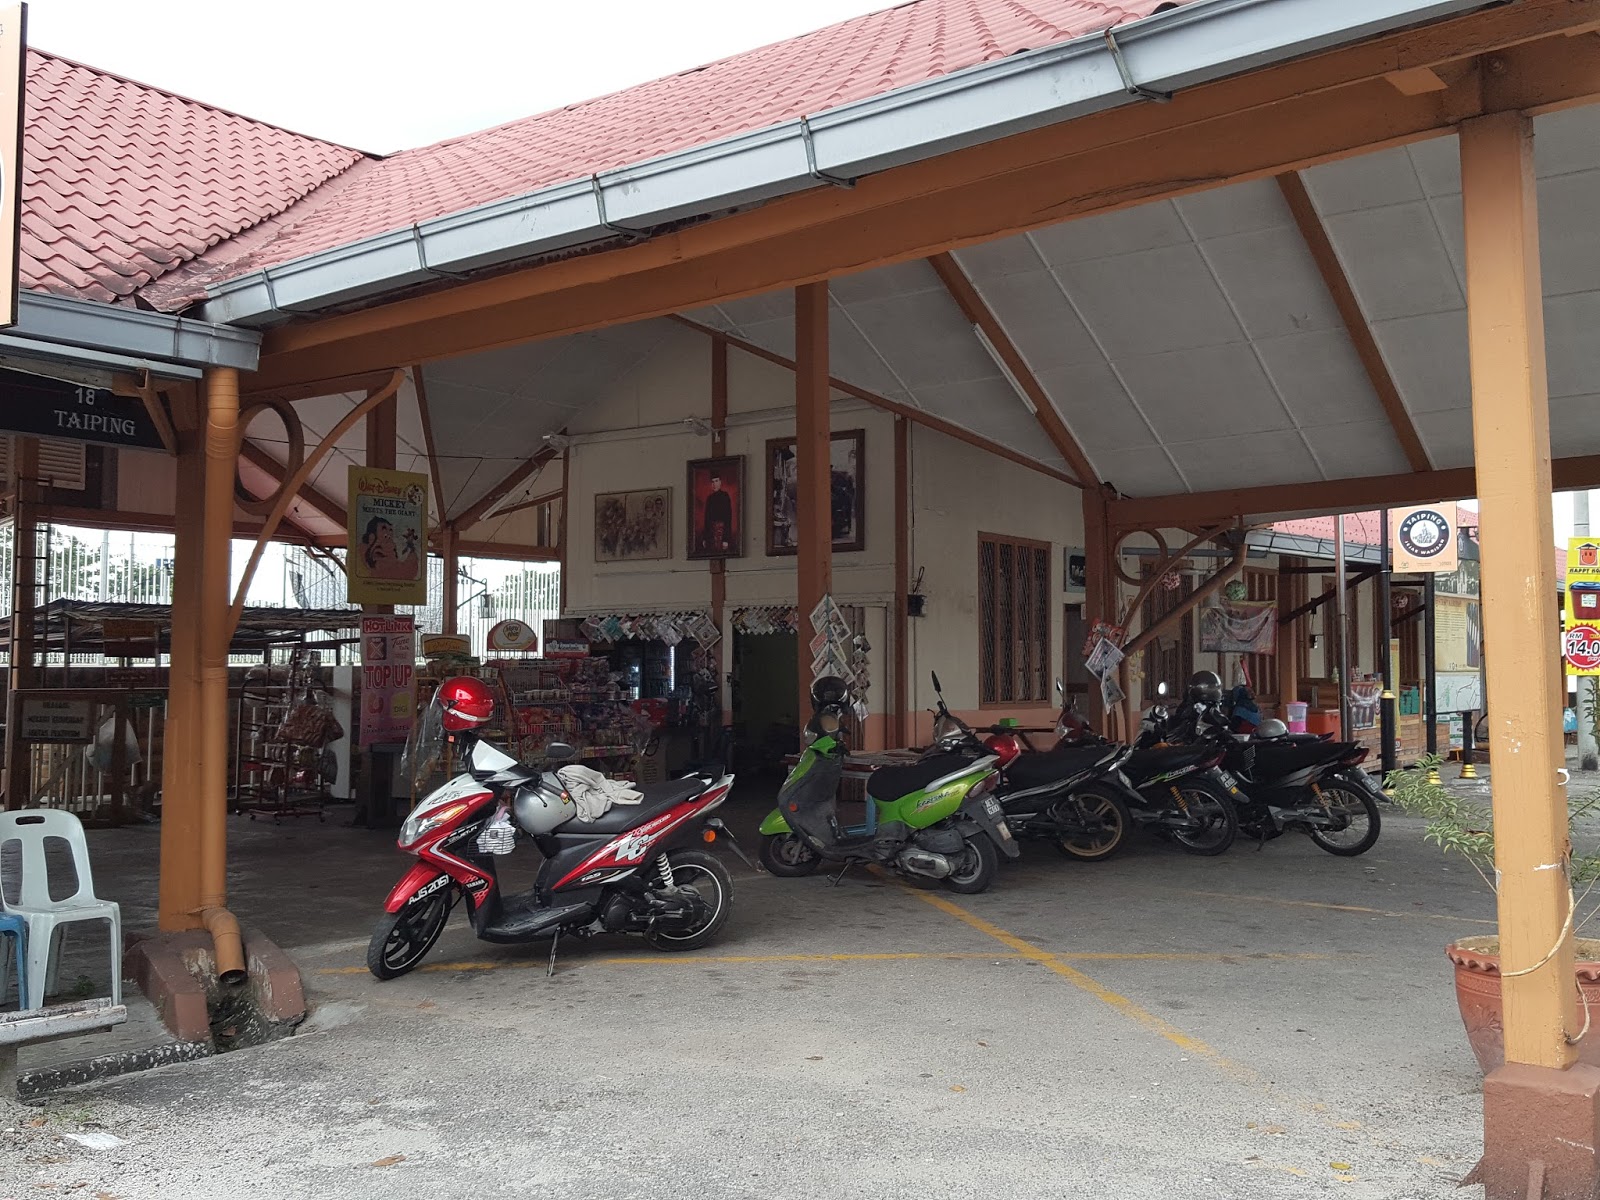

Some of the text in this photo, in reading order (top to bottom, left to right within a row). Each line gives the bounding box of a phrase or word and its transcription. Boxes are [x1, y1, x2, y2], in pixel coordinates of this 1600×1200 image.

[74, 387, 96, 406] 18
[53, 409, 137, 437] TAIPING
[373, 498, 407, 509] MICKEY
[362, 505, 417, 518] MEETS THE GIANT
[1406, 513, 1442, 526] TAIPING
[1420, 537, 1446, 555] WARISAN
[364, 663, 413, 690] TOP UP
[465, 879, 486, 889] YAMAHA
